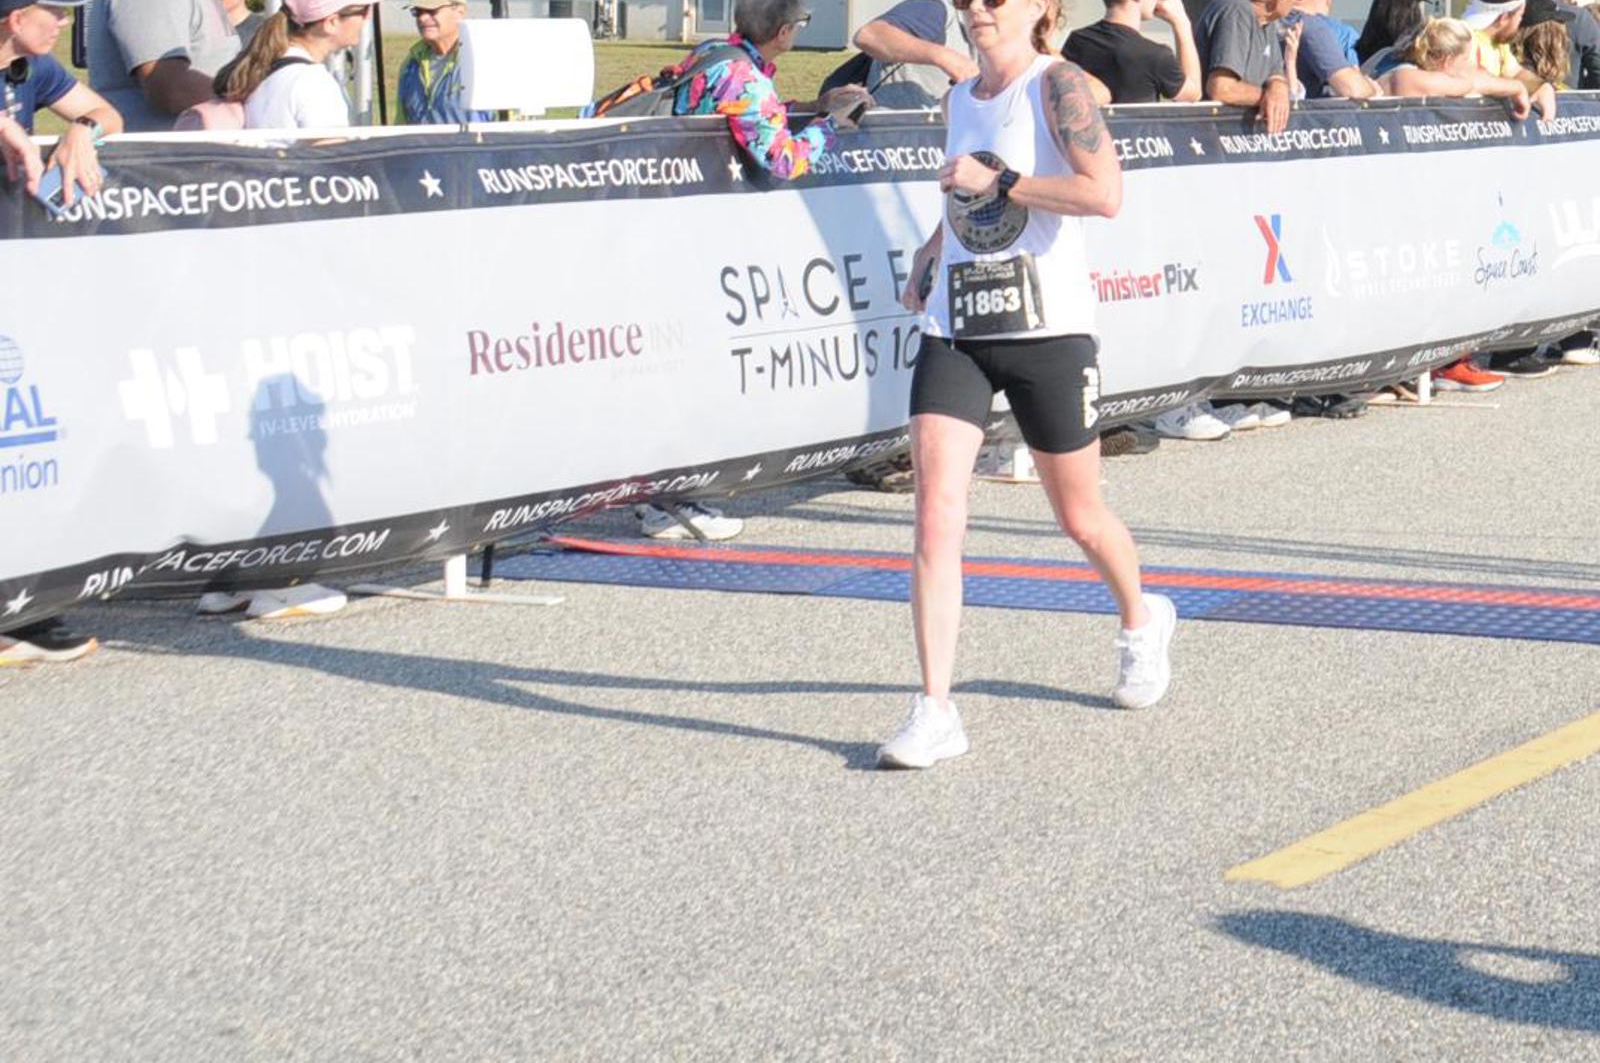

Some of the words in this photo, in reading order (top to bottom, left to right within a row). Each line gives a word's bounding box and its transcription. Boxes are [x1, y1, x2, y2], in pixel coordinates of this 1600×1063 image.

[478, 157, 704, 195] RUNSPACEFORCE.COM
[1344, 238, 1463, 280] STOKE
[720, 253, 871, 327] SPACE
[963, 286, 1021, 317] 1863
[1240, 300, 1314, 328] EXCHANGE
[241, 325, 417, 412] HOIST
[466, 321, 644, 377] Residence
[730, 327, 880, 395] T-MINUS
[329, 402, 418, 429] HYDRATION
